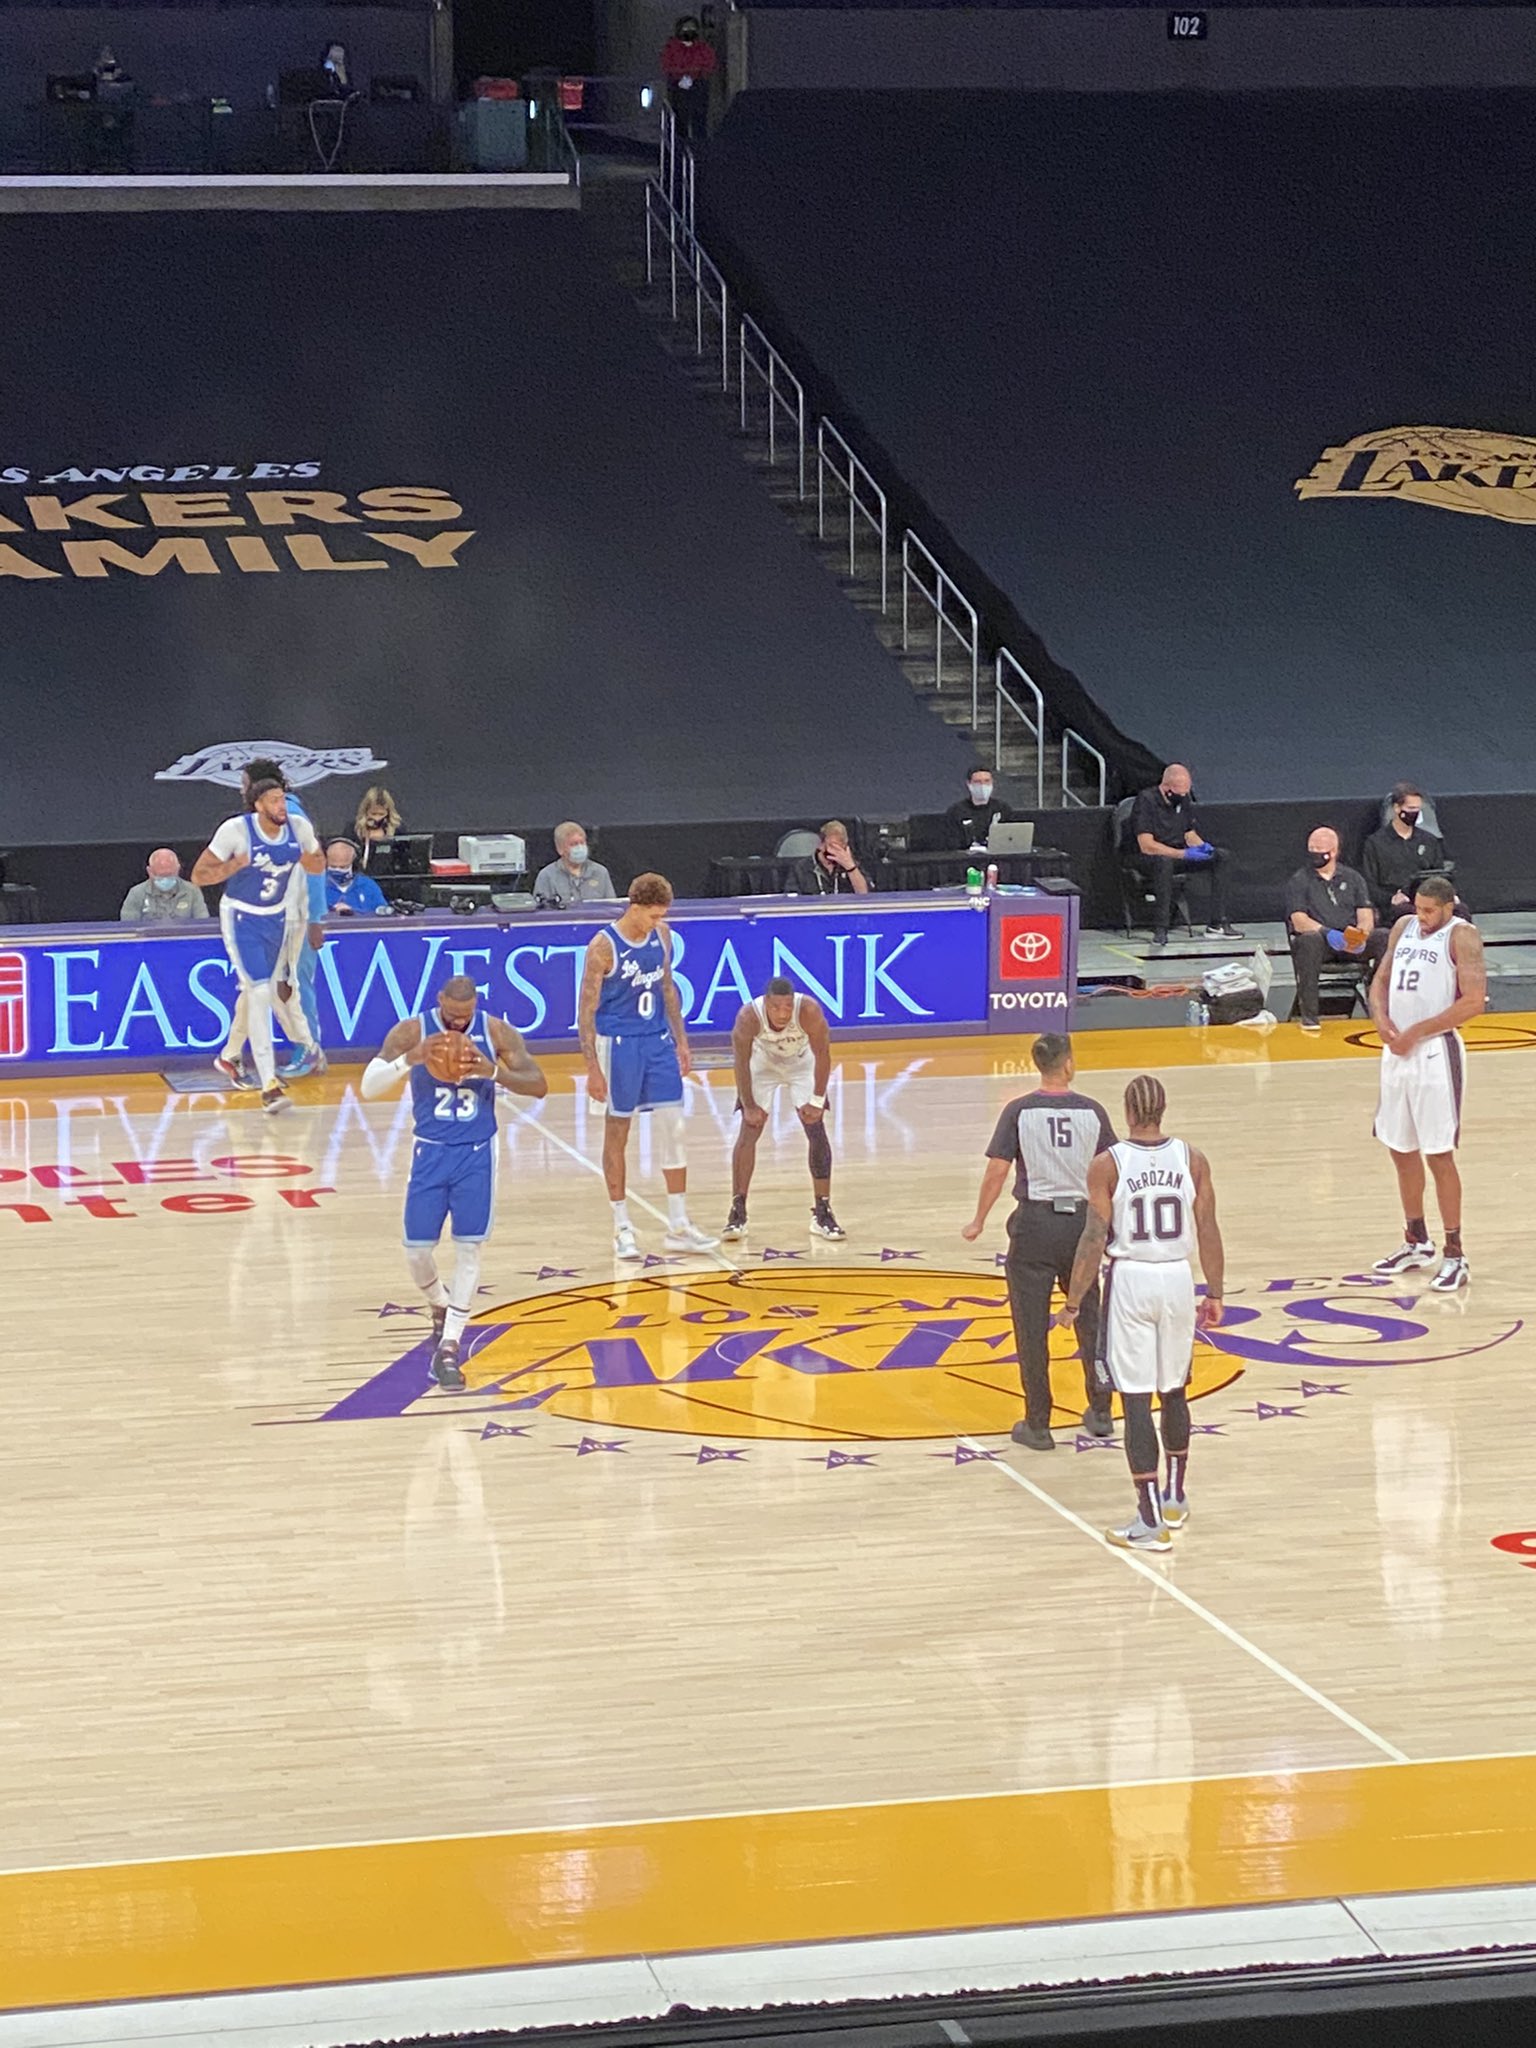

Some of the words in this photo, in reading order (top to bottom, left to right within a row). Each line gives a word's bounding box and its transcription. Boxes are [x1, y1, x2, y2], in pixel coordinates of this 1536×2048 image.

[1173, 16, 1200, 35] 102
[38, 461, 321, 484] ANGELES
[260, 877, 279, 901] 3
[1396, 969, 1420, 991] 12
[42, 949, 285, 1054] EAS
[638, 991, 656, 1020] 0
[989, 992, 1068, 1010] TOYOTA
[434, 1087, 479, 1122] 23
[1047, 1116, 1072, 1148] 15
[1129, 1194, 1184, 1243] 10
[605, 1304, 820, 1330] LOS
